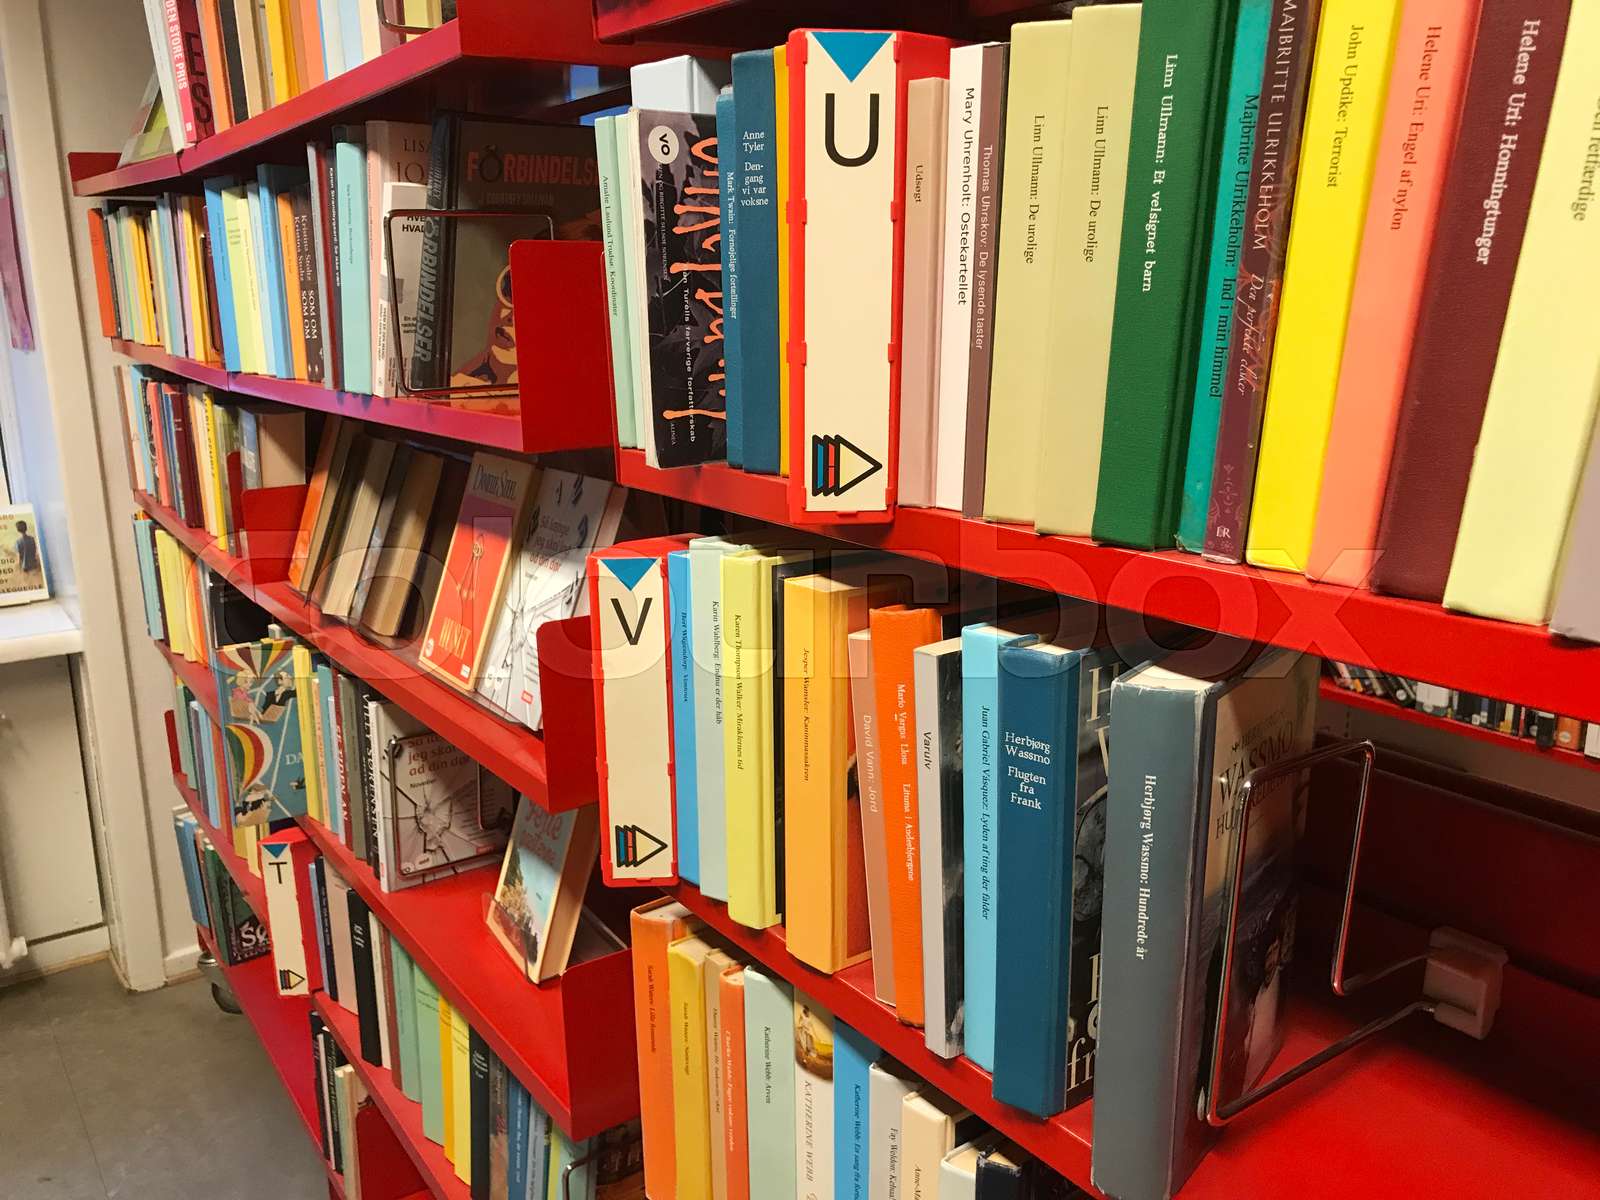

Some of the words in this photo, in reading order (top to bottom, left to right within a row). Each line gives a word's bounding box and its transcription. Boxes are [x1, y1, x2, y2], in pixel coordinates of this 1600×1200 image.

[170, 25, 183, 60] STORE
[1346, 25, 1364, 59] John
[1418, 26, 1442, 81] Helene
[1512, 20, 1541, 85] Helene
[176, 63, 188, 90] PRIS
[1163, 54, 1178, 88] Linn
[961, 88, 975, 124] Mary
[1336, 65, 1358, 122] Updike:
[1412, 87, 1432, 115] Uri:
[1095, 106, 1109, 135] Linn
[1504, 93, 1527, 127] Uri:
[742, 131, 765, 140] Anne
[824, 93, 880, 167] U
[1033, 115, 1046, 142] Linn
[1155, 96, 1173, 163] Ullmann:
[1236, 95, 1259, 165] Majbritte
[1402, 122, 1424, 165] Engel
[742, 142, 765, 154] Tyler
[1326, 127, 1348, 188] Terrorist
[466, 144, 600, 186] FÖRBINDELS
[744, 161, 764, 171] Den-
[744, 175, 764, 186] gang
[961, 130, 974, 207] Uhrenholt:
[981, 145, 993, 192] Thomas
[1028, 146, 1044, 200] Ullmann:
[1090, 139, 1107, 196] Ullmann:
[1152, 170, 1165, 185] Et
[1253, 112, 1283, 249] ULRIKKEHOLM
[1399, 170, 1413, 187] af
[726, 172, 735, 193] Mark
[742, 186, 750, 195] vi
[753, 186, 767, 195] var
[913, 164, 924, 203] Udsøgt
[727, 198, 736, 224] Twain:
[740, 196, 769, 207] voksne
[1028, 204, 1039, 221] De
[1088, 199, 1102, 217] De
[1390, 189, 1408, 231] nylon
[1475, 134, 1519, 265] Honningtunger
[979, 195, 991, 248] Uhrskov:
[1145, 191, 1162, 254] velsignet
[1225, 170, 1250, 268] Ulrikkeholm:
[728, 230, 737, 273] Fornøjelige
[1023, 224, 1037, 264] urolige
[1083, 221, 1098, 263] urolige
[957, 212, 971, 305] Ostekartellet
[978, 252, 989, 267] De
[976, 270, 988, 314] lysende
[1141, 261, 1155, 293] barn
[1220, 278, 1236, 299] Ind
[308, 290, 317, 316] SOM
[729, 275, 738, 319] fortællinger
[311, 319, 318, 339] OM
[975, 318, 985, 350] taster
[1214, 315, 1231, 342] min
[684, 327, 693, 372] farverige
[1208, 349, 1230, 398] himmel
[610, 597, 653, 646] V
[712, 601, 720, 622] Karin
[734, 614, 742, 638] Karen
[712, 624, 722, 659] Wahlberg:
[714, 663, 722, 686] Endnu
[734, 640, 743, 679] Thompson
[802, 648, 810, 674] Jesper
[735, 682, 743, 710] Walker:
[897, 684, 906, 708] Mario
[863, 715, 872, 747] David
[897, 712, 907, 739] Vargas
[981, 705, 990, 727] Juan
[923, 731, 932, 770] Varulv
[981, 730, 991, 765] Gabriel
[1005, 732, 1051, 755] Herbjørg
[1005, 745, 1051, 765] Wassmo
[865, 751, 876, 784] Vann:
[1008, 766, 1047, 785] Flugten
[868, 787, 878, 813] Jord
[980, 769, 991, 811] Vásquez:
[1010, 791, 1043, 810] Frank
[1019, 782, 1035, 795] fra
[1139, 774, 1157, 829] Herbjørg
[980, 813, 990, 842] Lyden
[980, 856, 991, 873] ting
[981, 844, 991, 854] af
[1139, 833, 1154, 884] Wassmo:
[268, 861, 287, 885] T
[981, 875, 991, 890] der
[980, 891, 991, 920] falder
[1136, 887, 1151, 944] Hundrede
[1135, 946, 1149, 960] år
[804, 1080, 814, 1148] KATHERINE
[889, 1128, 898, 1142] Fay
[806, 1151, 814, 1182] WEBB
